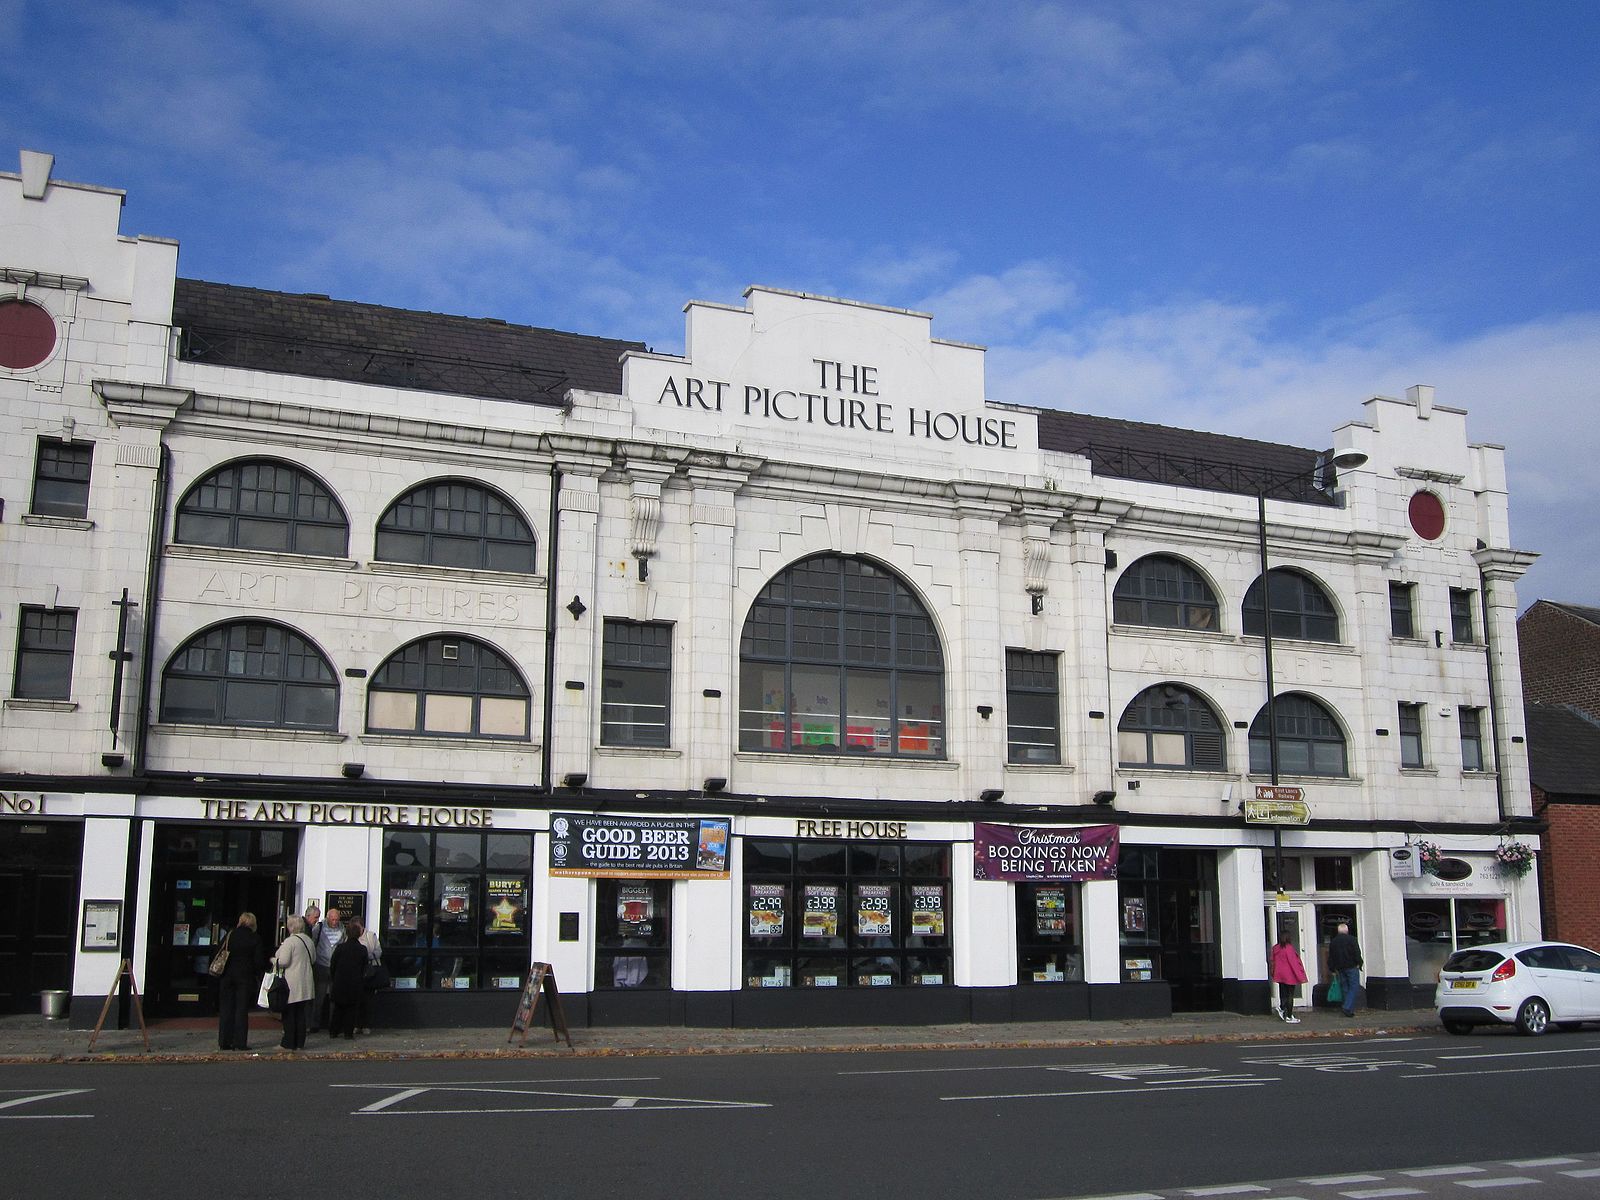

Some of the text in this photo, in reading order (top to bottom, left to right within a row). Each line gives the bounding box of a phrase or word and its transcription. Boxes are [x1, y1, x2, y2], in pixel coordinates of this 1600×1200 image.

[812, 358, 879, 396] THE
[657, 375, 1018, 450] ART PICTURE HOUSE
[198, 568, 520, 623] ART PICTURES
[1139, 646, 1215, 673] ART
[200, 799, 494, 827] THE ART PICTURE HOUSE
[582, 828, 690, 845] GOOD BEER
[796, 819, 908, 840] FREE HOUSE
[1018, 829, 1081, 845] Christmas
[582, 844, 690, 861] GUIDE 2013
[988, 845, 1108, 859] BOOKINGS NOW
[1001, 859, 1096, 872] BEING TAKEN
[489, 880, 521, 888] BURY'S
[752, 897, 781, 910] £2.99
[806, 896, 836, 909] £3.99
[860, 897, 888, 910] £2.99
[914, 896, 941, 909] £3.99
